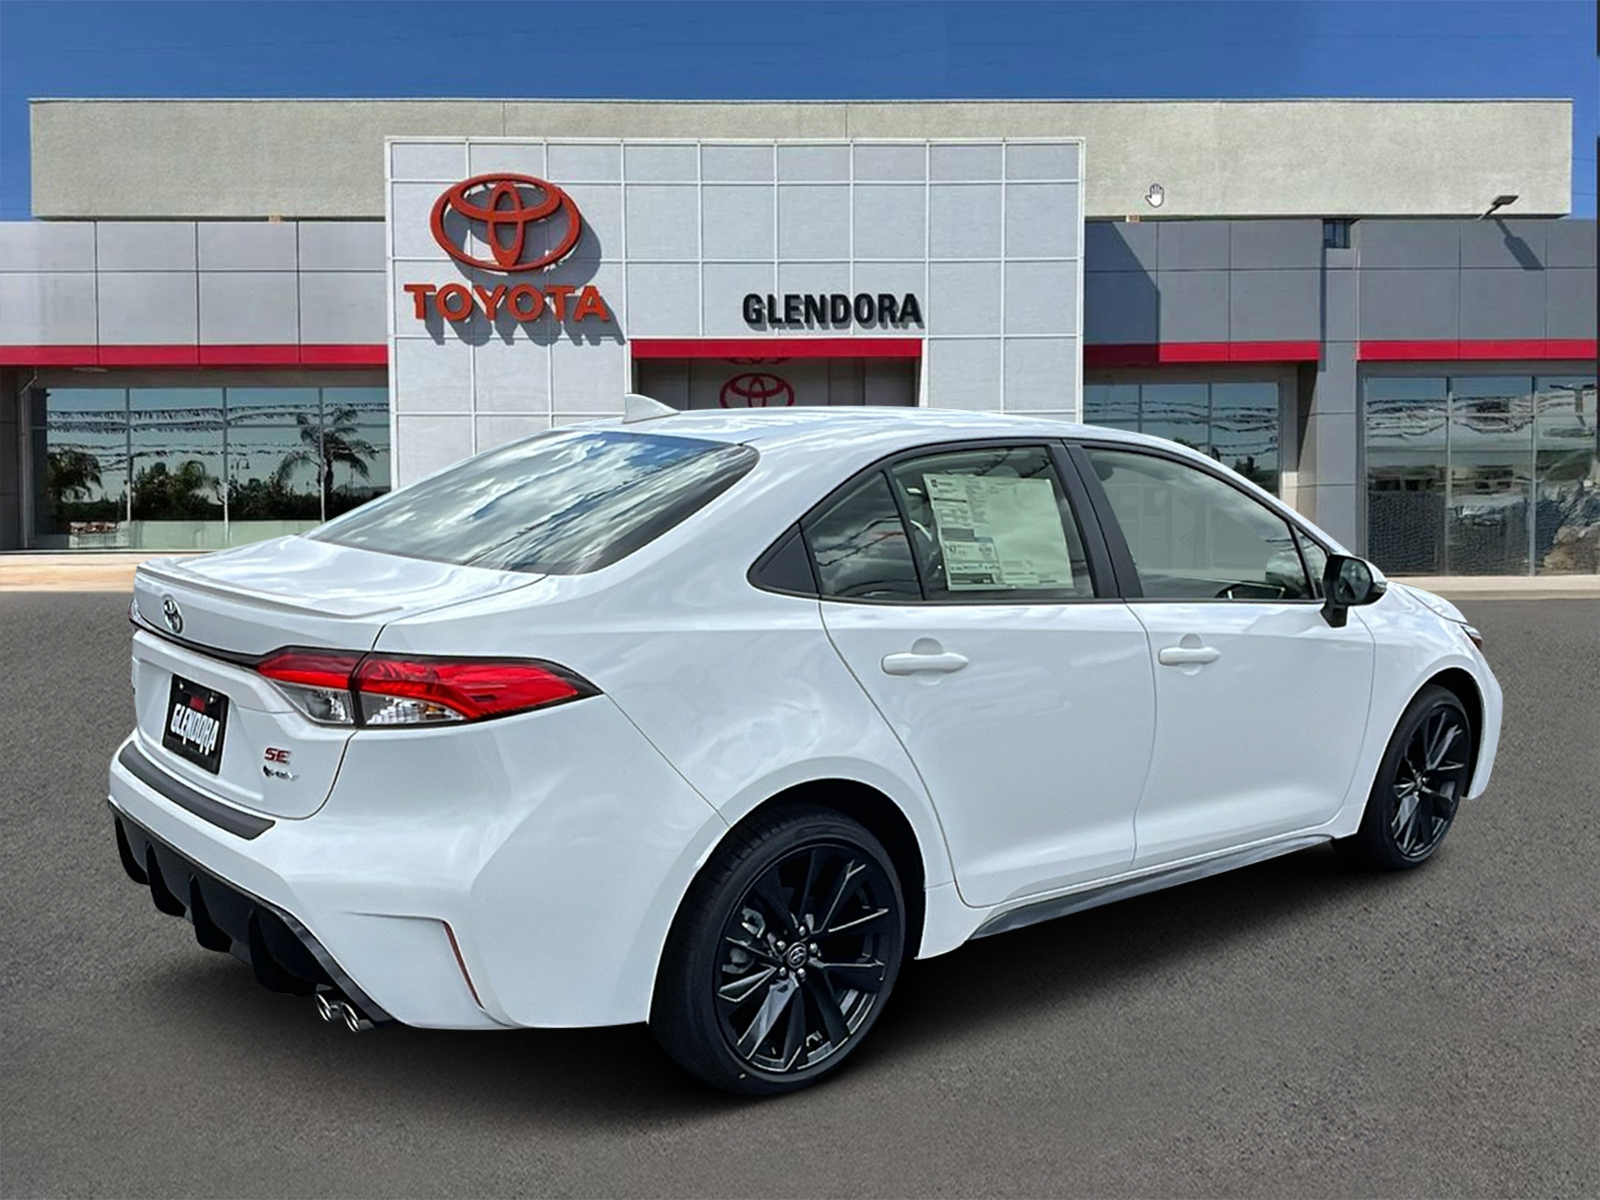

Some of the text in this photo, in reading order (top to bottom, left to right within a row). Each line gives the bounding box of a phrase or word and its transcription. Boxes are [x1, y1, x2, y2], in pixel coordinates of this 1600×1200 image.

[404, 283, 610, 323] TOYOTA
[742, 293, 923, 326] GLENDORA
[170, 703, 220, 756] GLENDORA
[264, 747, 291, 764] SE
